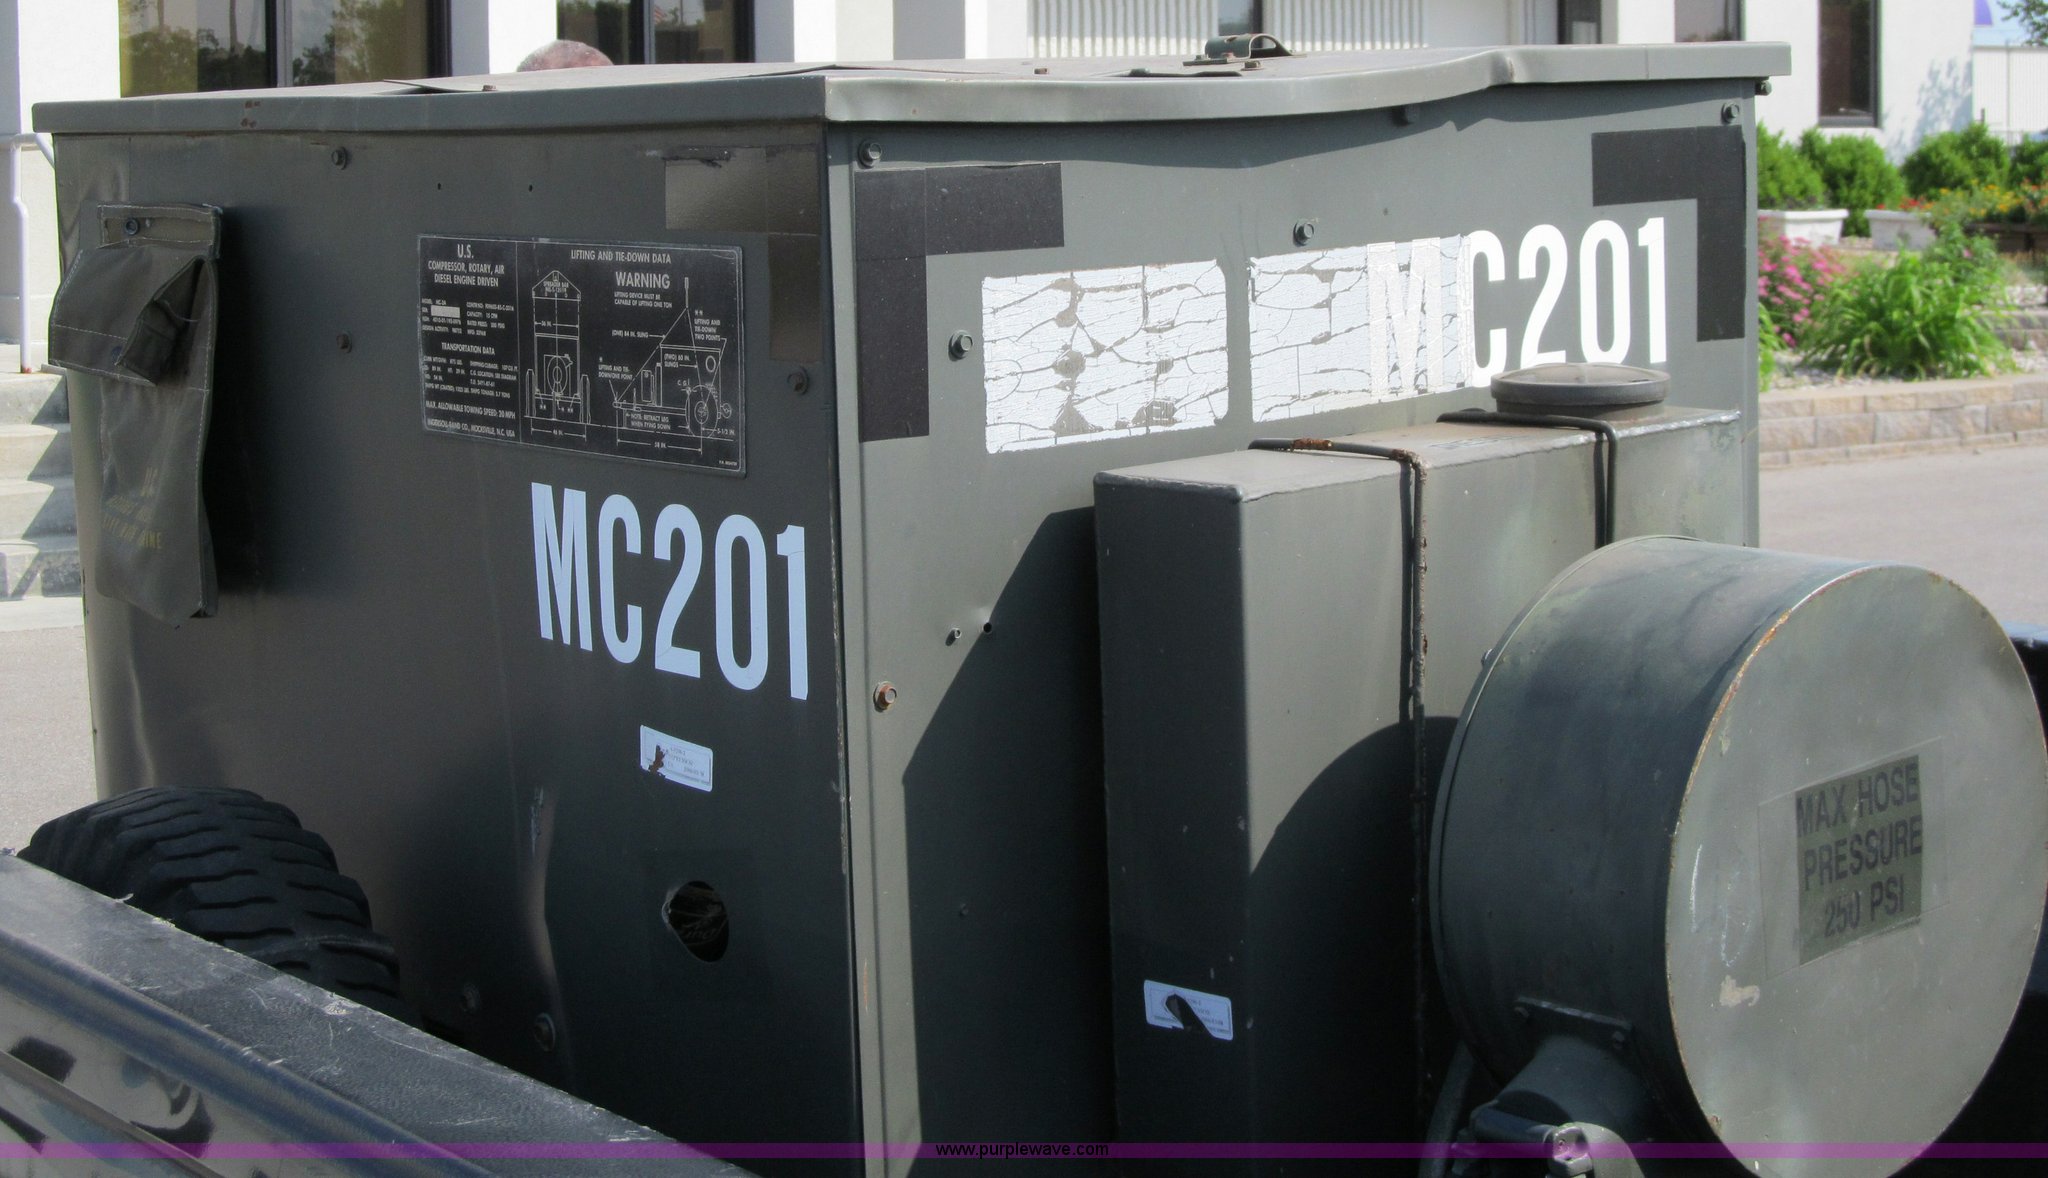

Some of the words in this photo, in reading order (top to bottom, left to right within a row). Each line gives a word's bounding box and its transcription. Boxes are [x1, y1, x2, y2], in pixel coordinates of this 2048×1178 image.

[457, 244, 474, 259] U.S.
[571, 249, 596, 260] LIFTING
[598, 250, 613, 260] AND
[615, 252, 650, 263] TIE-DOWN
[652, 253, 671, 264] DATA
[428, 260, 467, 273] COMPRESSOR,
[468, 263, 493, 275] ROTARY,
[494, 265, 505, 274] AIR
[434, 273, 453, 284] DIESEL
[454, 274, 476, 286] ENGINE
[477, 276, 499, 287] DRIVEN
[615, 271, 670, 289] WARNING
[441, 342, 481, 353] TRANSPORTATION
[482, 346, 495, 355] DATA
[426, 400, 437, 409] MAX.
[438, 402, 463, 412] ALLOWABLE
[464, 405, 483, 415] TOWING
[505, 410, 516, 419] MPH
[531, 482, 808, 701] MC201
[1796, 785, 1847, 838] MAX
[1857, 762, 1919, 818] HOSE
[1803, 814, 1922, 891] PRESSURE
[1824, 889, 1860, 938] 250
[1870, 874, 1905, 922] PSI
